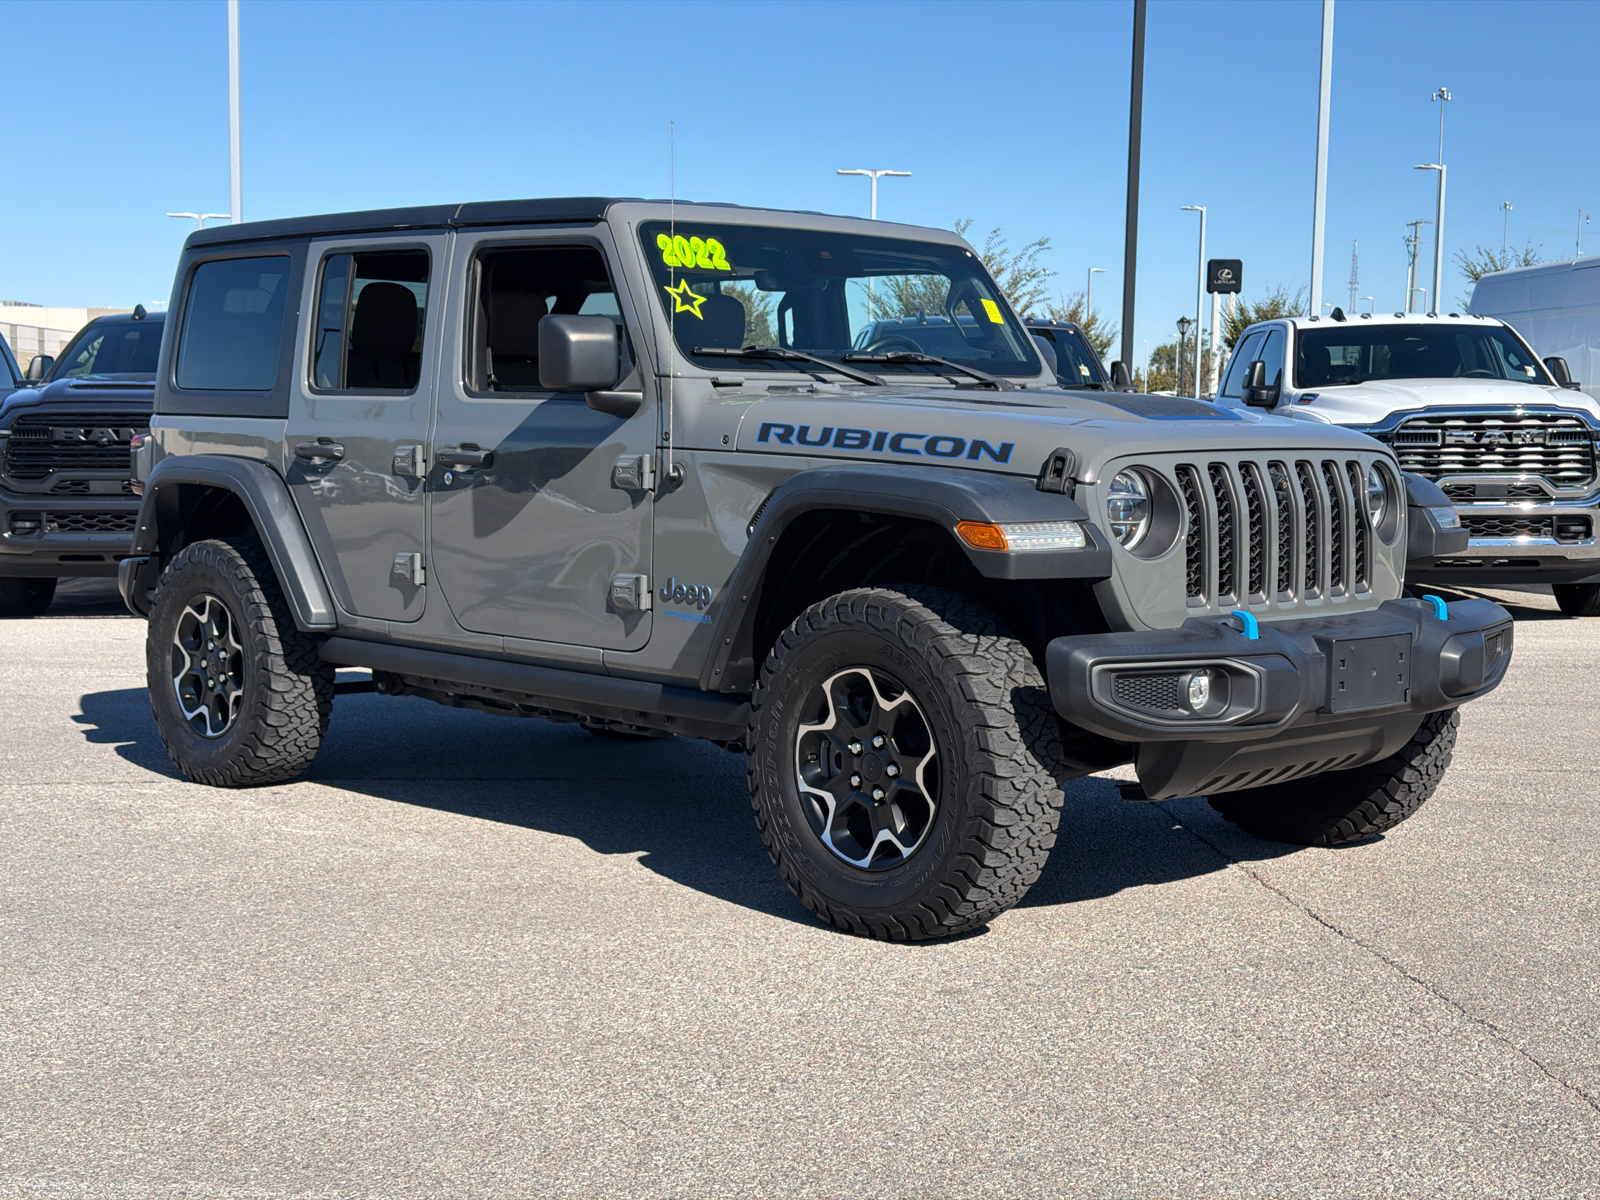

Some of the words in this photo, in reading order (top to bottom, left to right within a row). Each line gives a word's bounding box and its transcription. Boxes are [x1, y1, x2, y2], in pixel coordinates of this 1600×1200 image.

[656, 234, 731, 271] 2022
[756, 422, 1015, 464] RUBICON
[1444, 428, 1546, 445] RAM
[659, 576, 712, 610] Jeep
